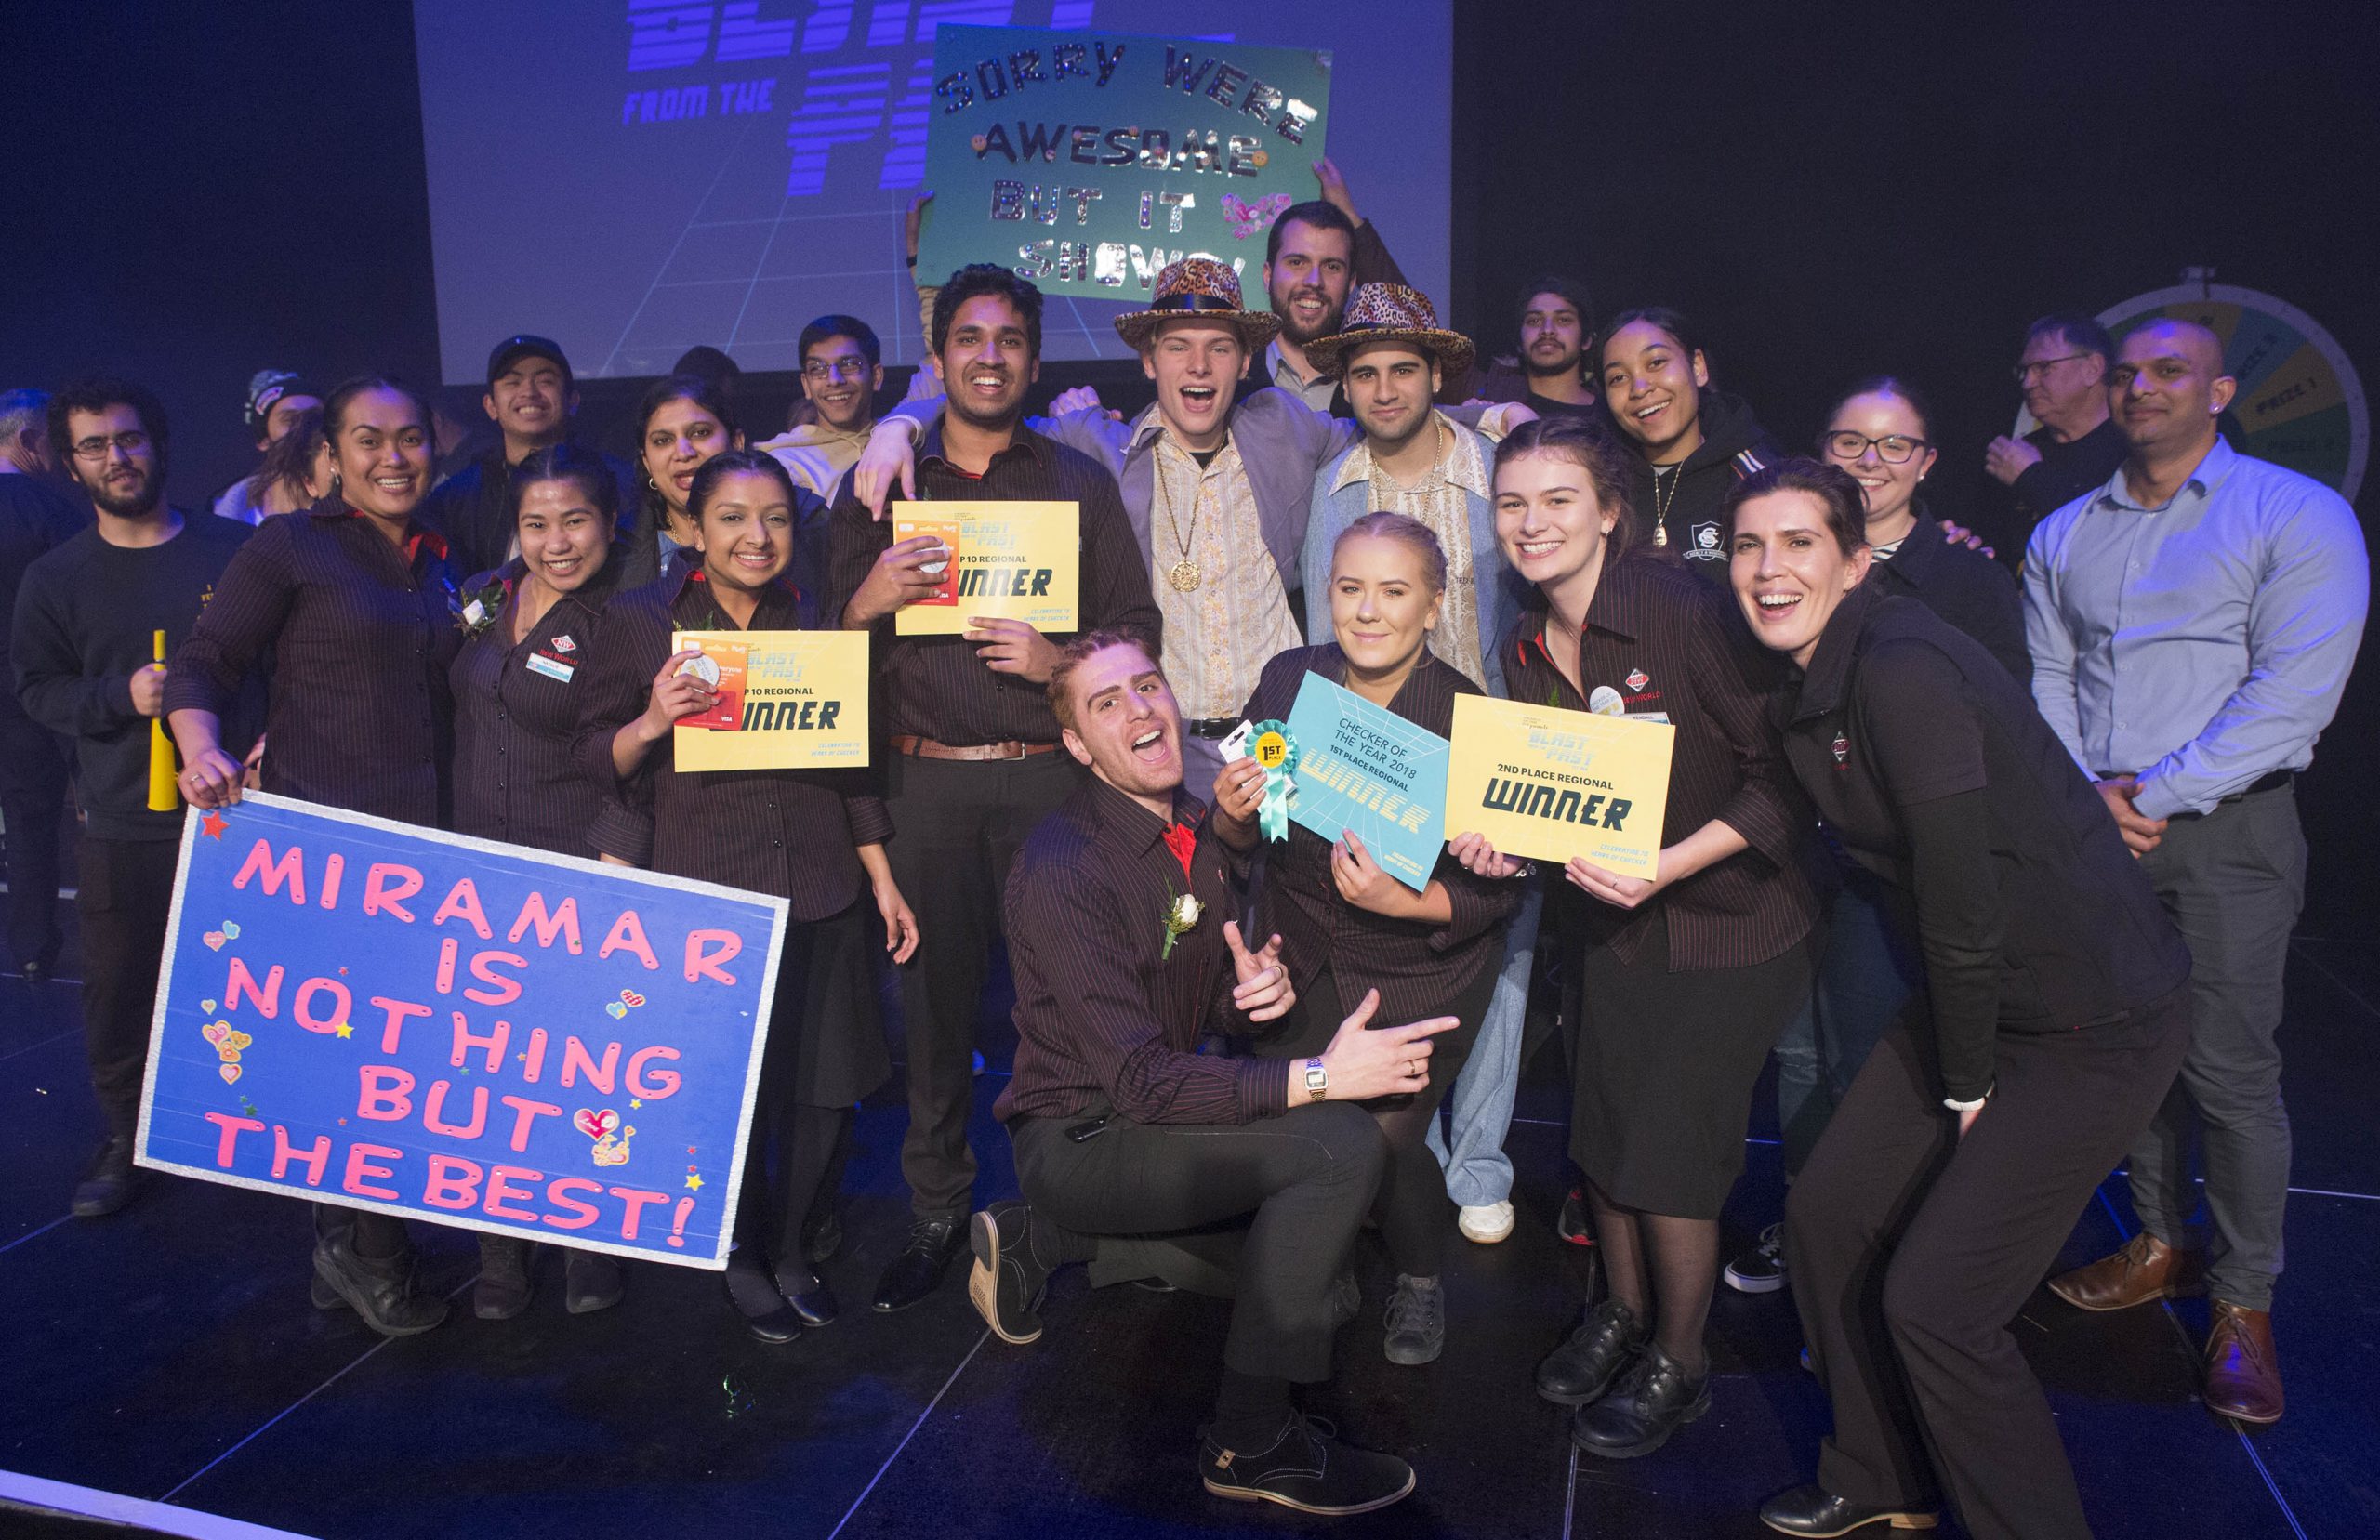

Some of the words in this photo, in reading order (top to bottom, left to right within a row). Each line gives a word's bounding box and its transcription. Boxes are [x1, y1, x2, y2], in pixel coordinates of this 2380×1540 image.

[623, 86, 709, 125] FROM
[720, 78, 776, 115] THE
[937, 41, 1125, 114] SORRY
[1164, 44, 1317, 145] WERE
[976, 121, 1262, 177] AWESOME
[990, 179, 1102, 225] BUT
[1139, 191, 1195, 232] IT
[958, 568, 1052, 596] INNER
[553, 653, 578, 665] WORLD
[709, 701, 841, 731] INNER
[764, 687, 814, 695] REGIONAL
[1263, 745, 1281, 761] 1ST
[1334, 729, 1356, 747] THE
[1359, 742, 1387, 764] YEAR
[1389, 759, 1417, 779] 2018
[1339, 718, 1389, 750] CHECKER
[1390, 745, 1408, 757] OF
[1298, 748, 1433, 834] WINNER
[1330, 744, 1344, 756] 1ST
[1343, 752, 1368, 770] PLACE
[1368, 766, 1408, 792] REGIONAL
[1497, 763, 1519, 774] 2ND
[1521, 768, 1555, 781] PLACE
[1557, 773, 1614, 790] REGIONAL
[1482, 778, 1633, 831] WINNER
[233, 838, 742, 986] MIRAMAR
[436, 938, 528, 1006] IS
[224, 957, 681, 1099] NOTHING
[357, 1065, 562, 1152] BUT
[205, 1112, 403, 1201] THE
[423, 1153, 695, 1247] BEST!
